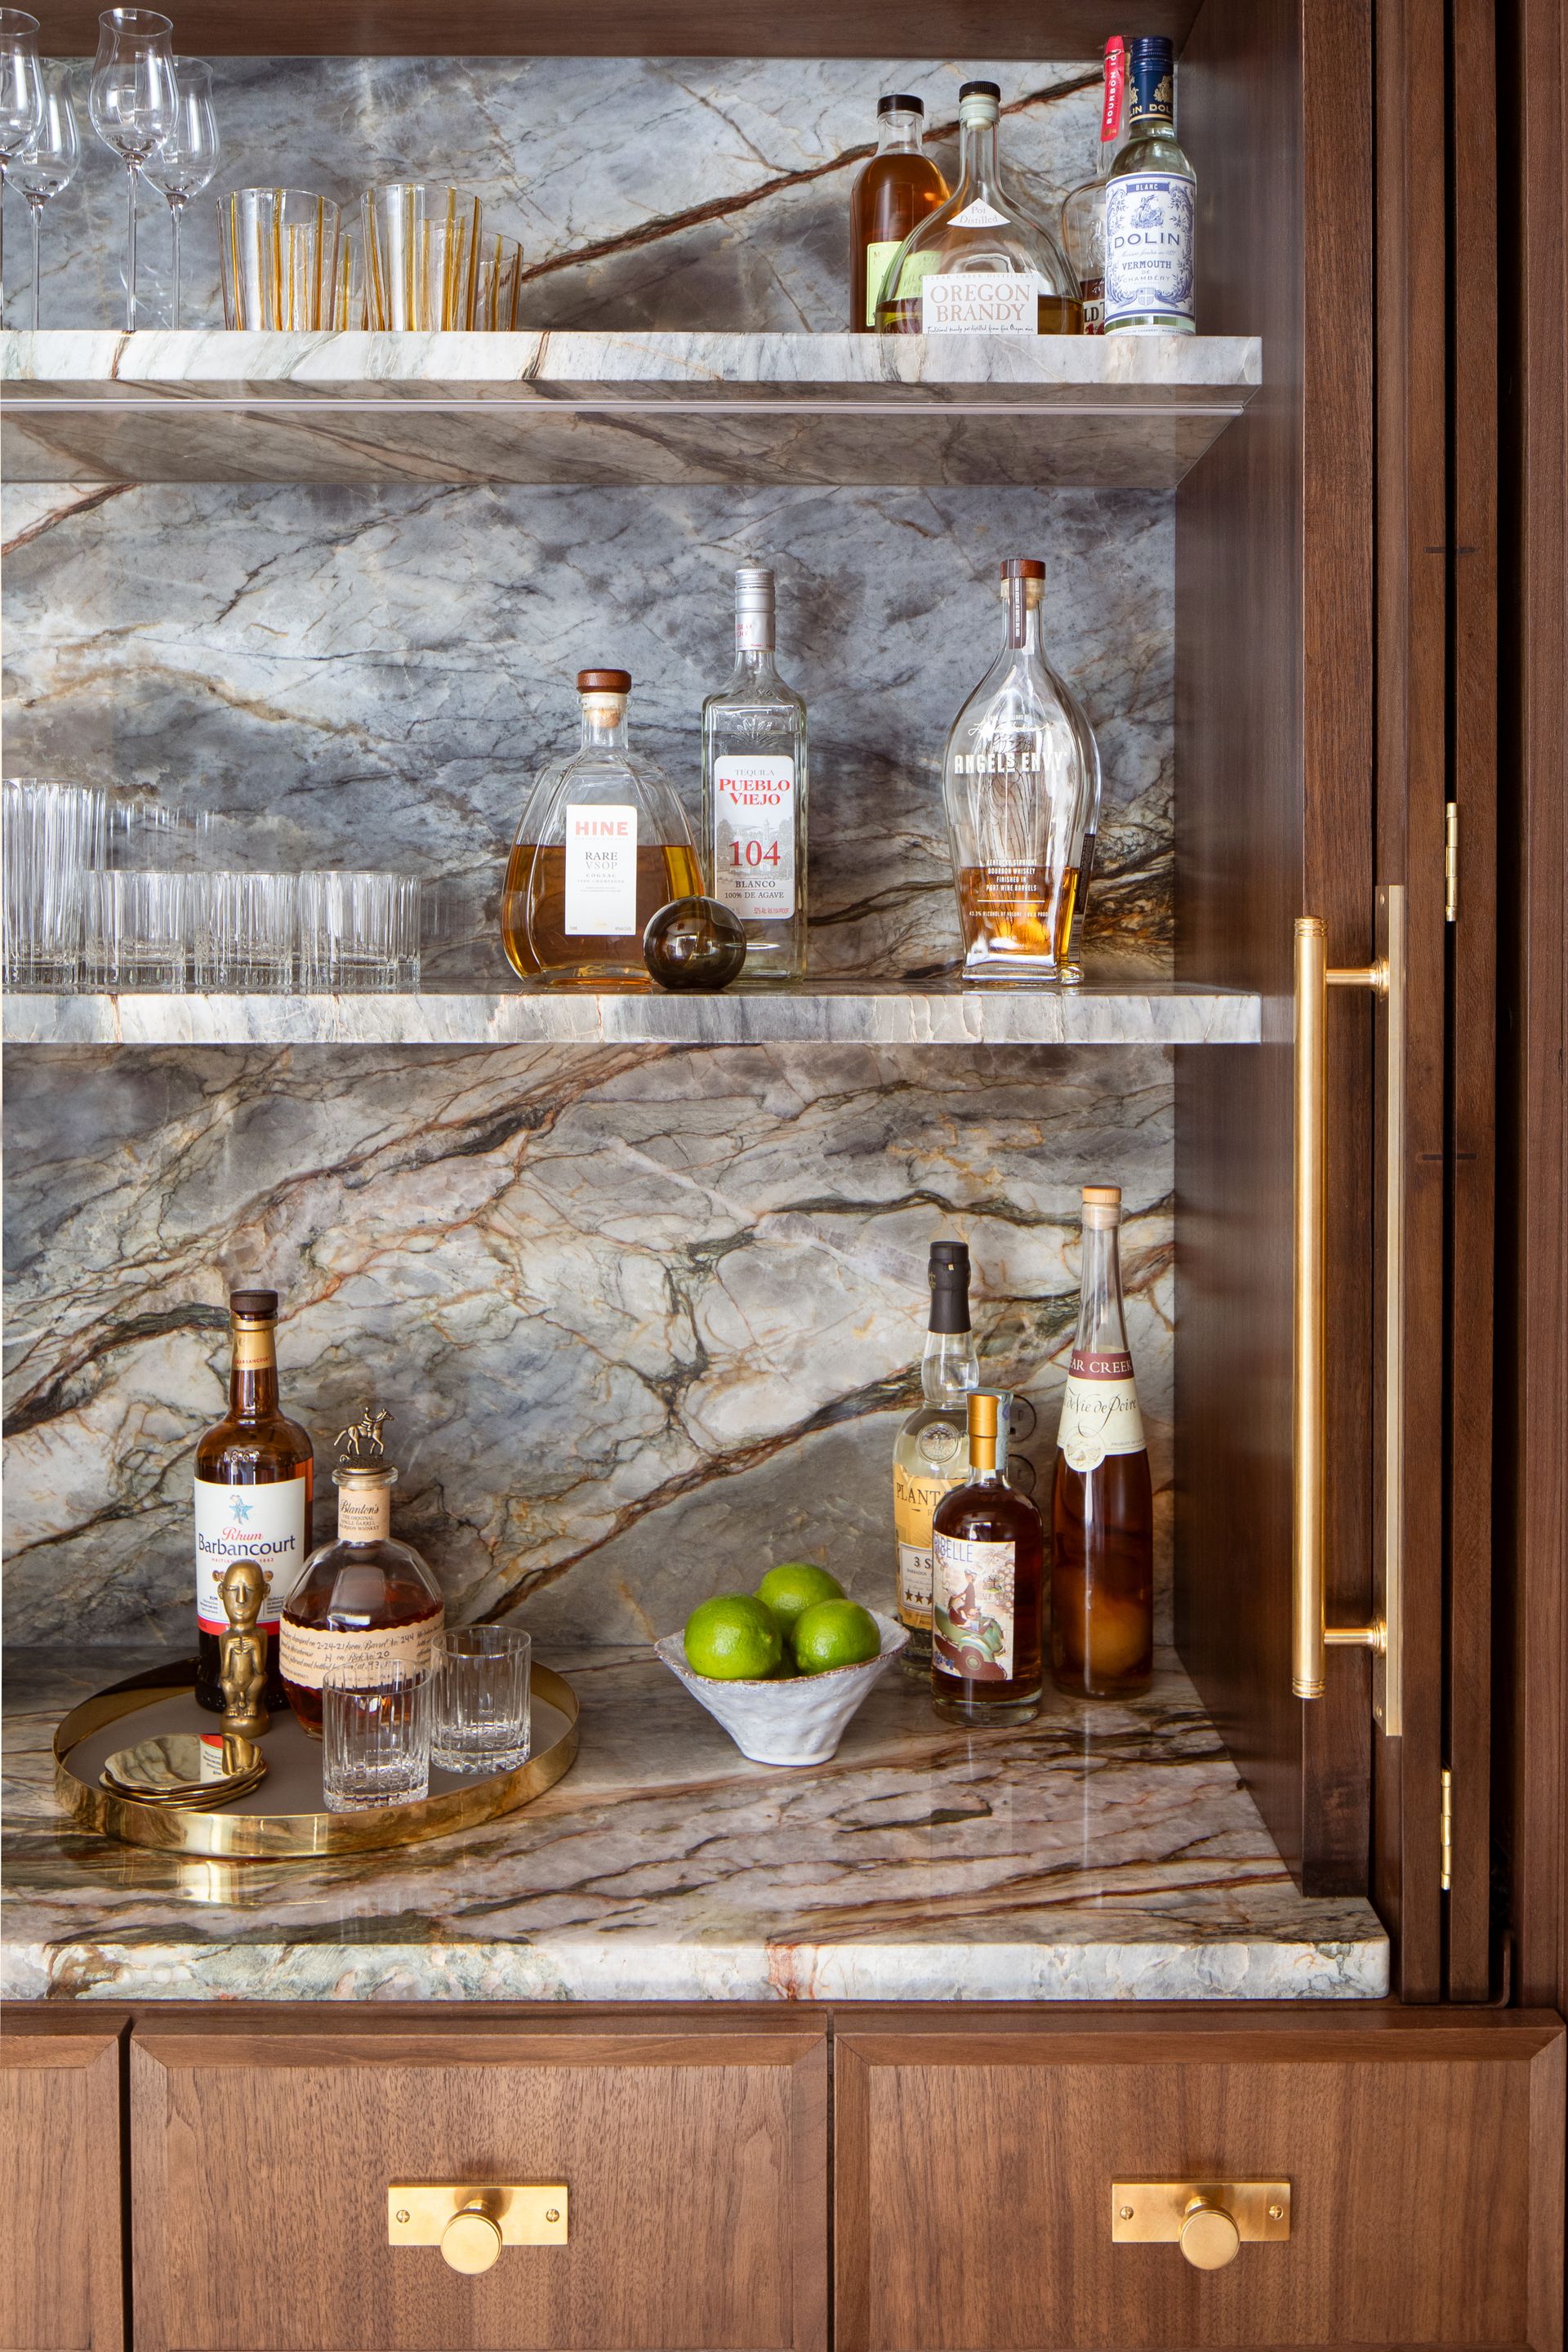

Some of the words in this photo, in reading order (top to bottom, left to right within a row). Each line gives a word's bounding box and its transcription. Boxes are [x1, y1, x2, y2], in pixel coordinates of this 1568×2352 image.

[1106, 71, 1116, 124] BOURBON
[971, 206, 986, 214] Pot
[960, 216, 999, 224] Distilled
[1114, 233, 1180, 248] DOLIN
[1122, 260, 1172, 270] VERMOUTH
[929, 283, 1031, 303] OREGON
[936, 303, 1026, 323] BRANDY
[719, 778, 791, 791] PUEBLO
[729, 792, 781, 806] VIEJO
[575, 821, 629, 836] HINE
[585, 851, 618, 861] RARE
[728, 840, 782, 867] 104
[585, 861, 617, 870] VSOP
[1089, 1359, 1133, 1374] CREEK
[1094, 1400, 1107, 1414] de
[340, 1499, 380, 1515] Blanton's
[221, 1526, 263, 1542] Rhum
[198, 1533, 296, 1556] Barbancourt
[914, 1556, 920, 1567] 3
[400, 1633, 414, 1643] 244
[376, 1650, 390, 1659] 20
